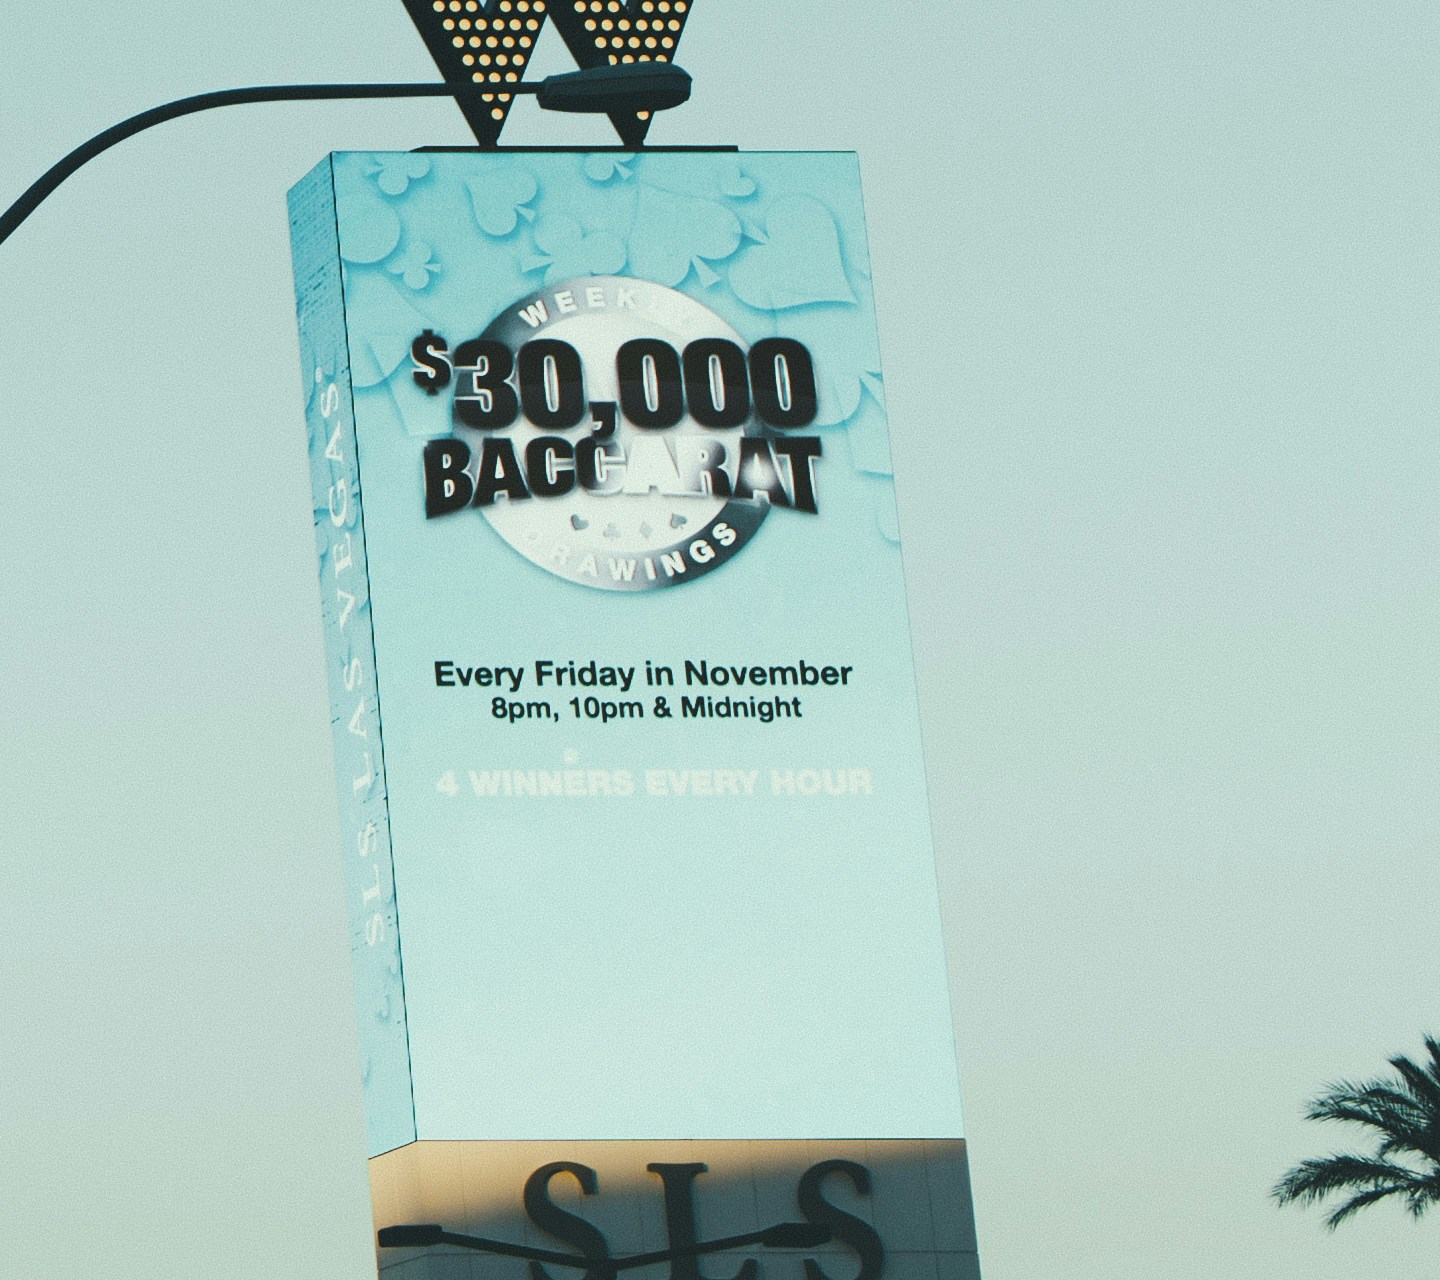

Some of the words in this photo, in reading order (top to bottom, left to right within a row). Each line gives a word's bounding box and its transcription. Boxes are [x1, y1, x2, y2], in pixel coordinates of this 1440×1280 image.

[518, 286, 662, 329] WEEK
[411, 329, 819, 438] $30,000
[320, 382, 356, 633] VEGAS
[423, 435, 822, 519] BACCARAT
[435, 661, 523, 693] Every
[536, 661, 634, 692] Friday
[646, 661, 673, 686] in
[685, 661, 852, 686] November
[343, 656, 375, 793] LAS
[492, 697, 559, 723] 8pm,
[570, 697, 643, 723] 10pm
[654, 697, 671, 718] &
[682, 697, 802, 723] Midnight
[436, 770, 460, 797] 4
[469, 769, 635, 797] WINNERS
[645, 769, 759, 796] EVERY
[770, 768, 873, 796] HOUR
